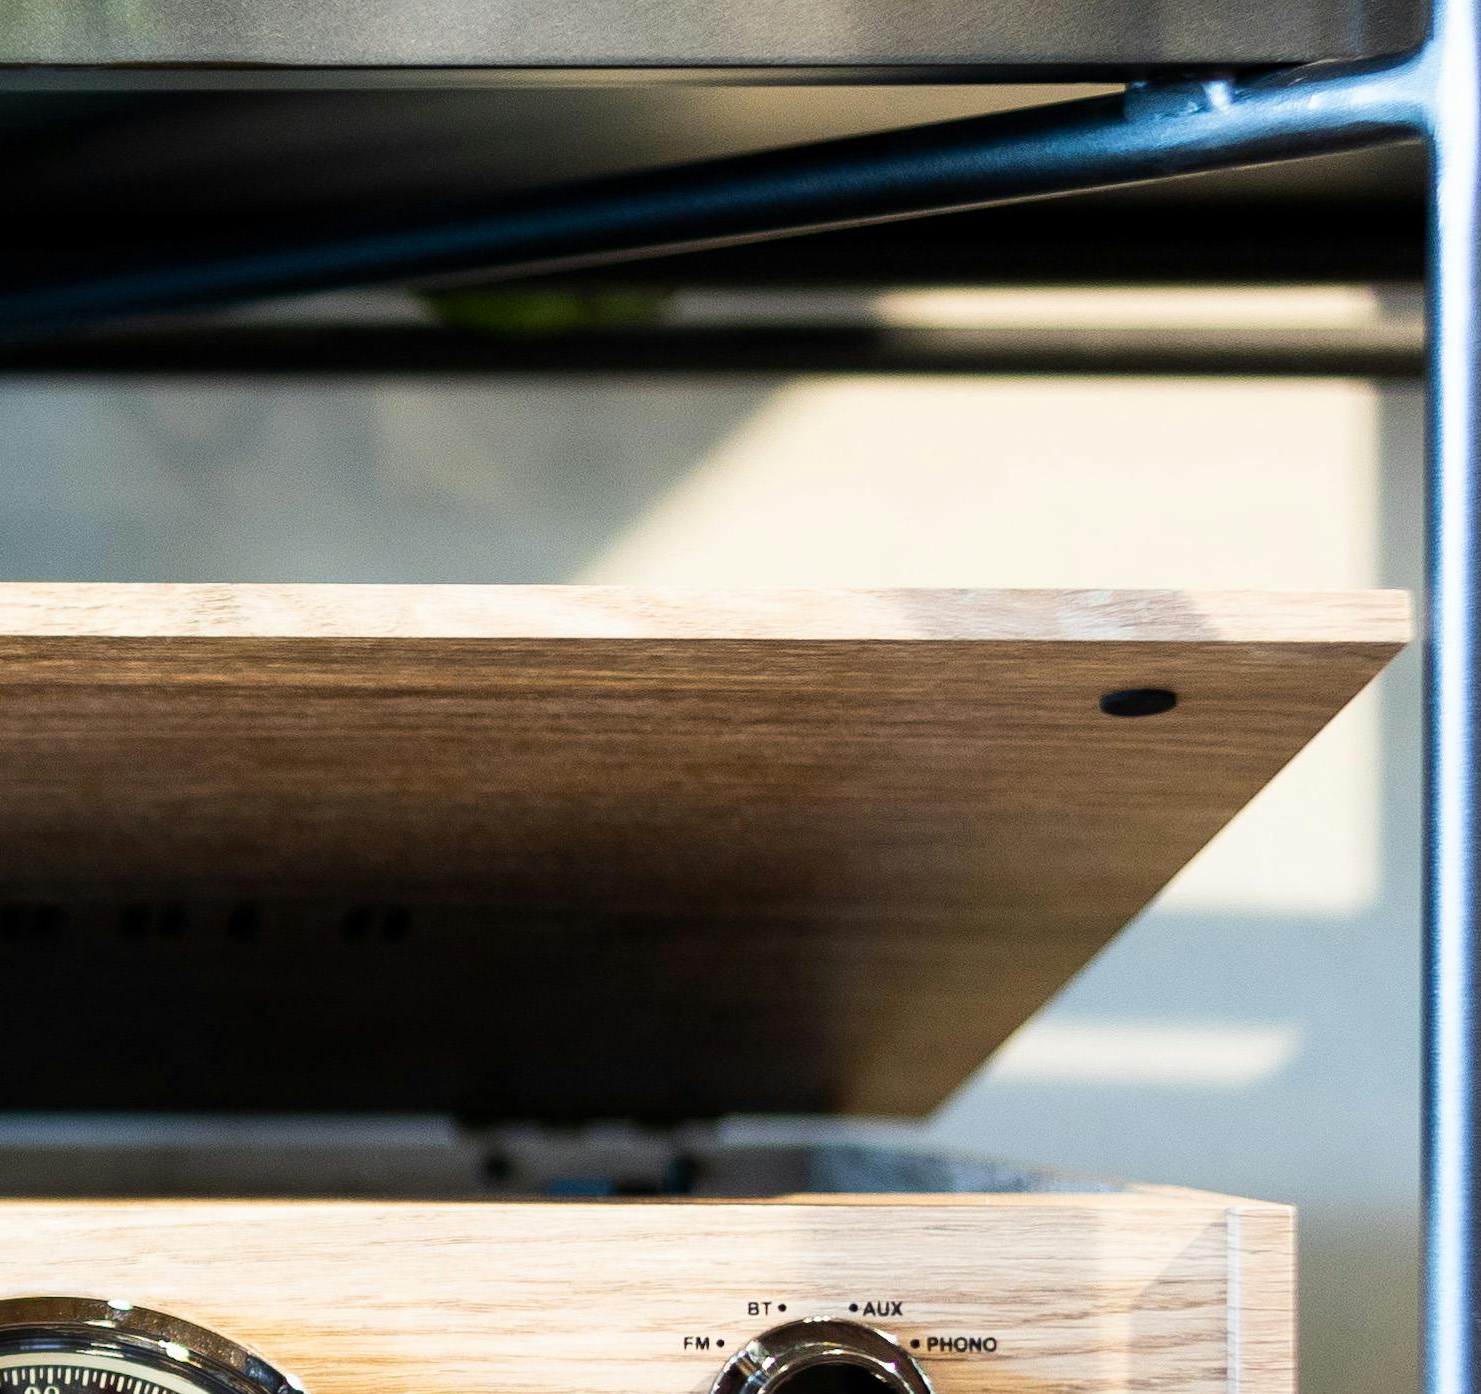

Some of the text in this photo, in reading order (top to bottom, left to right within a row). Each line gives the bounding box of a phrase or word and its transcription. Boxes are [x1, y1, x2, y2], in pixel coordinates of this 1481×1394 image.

[748, 1302, 772, 1316] BT
[863, 1302, 903, 1316] AUX
[683, 1337, 710, 1350] FM
[927, 1337, 997, 1352] PHONO
